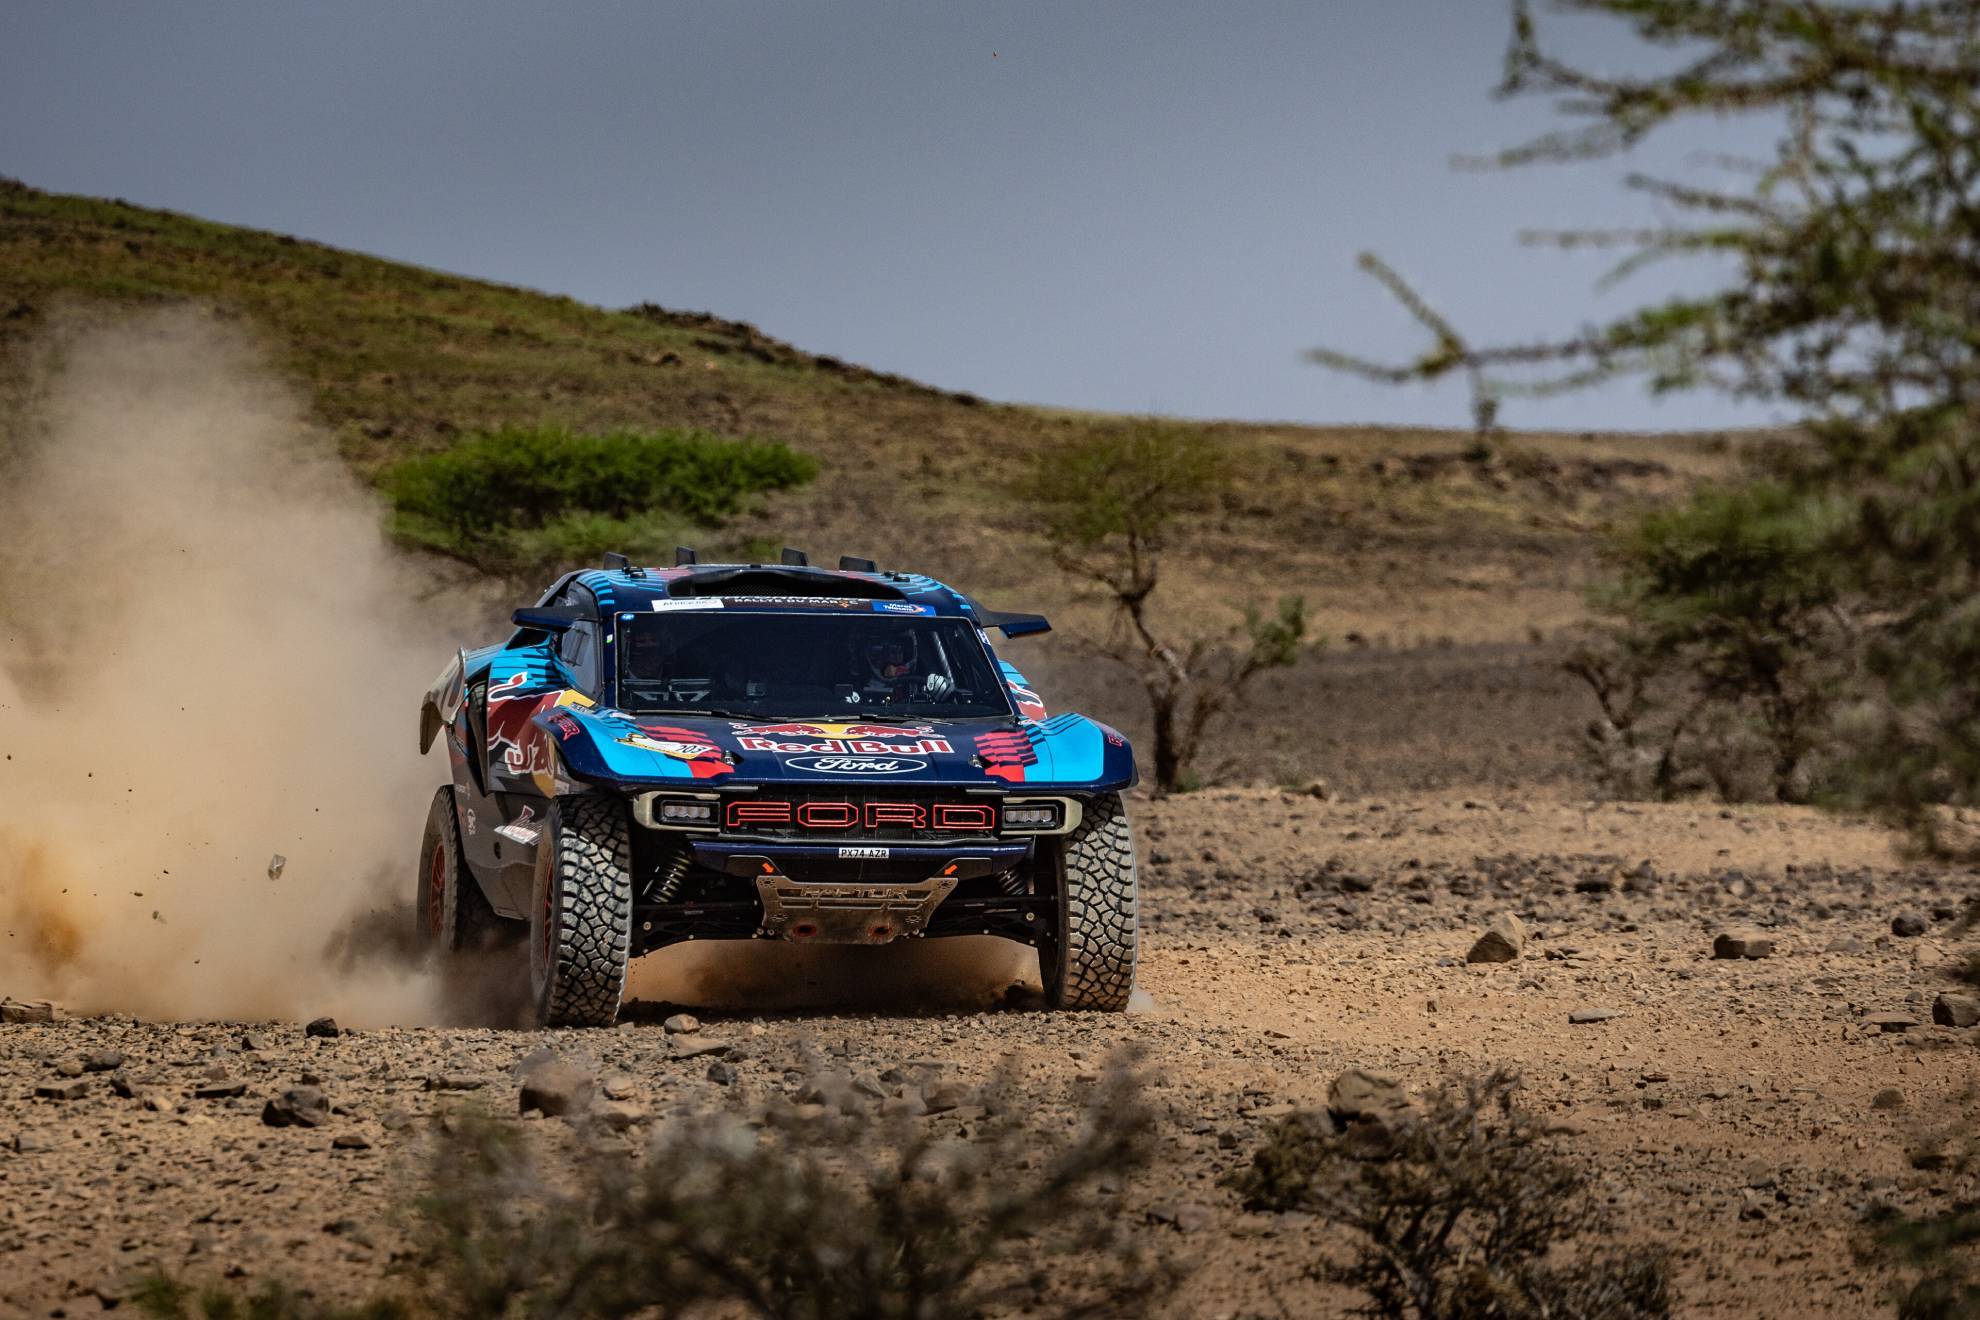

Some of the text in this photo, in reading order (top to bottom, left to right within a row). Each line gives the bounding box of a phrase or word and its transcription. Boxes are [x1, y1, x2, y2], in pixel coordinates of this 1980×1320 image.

[738, 736, 954, 755] Red Bull
[814, 757, 900, 772] Ford
[727, 801, 996, 830] FORD
[841, 849, 888, 858] PX74 AZR
